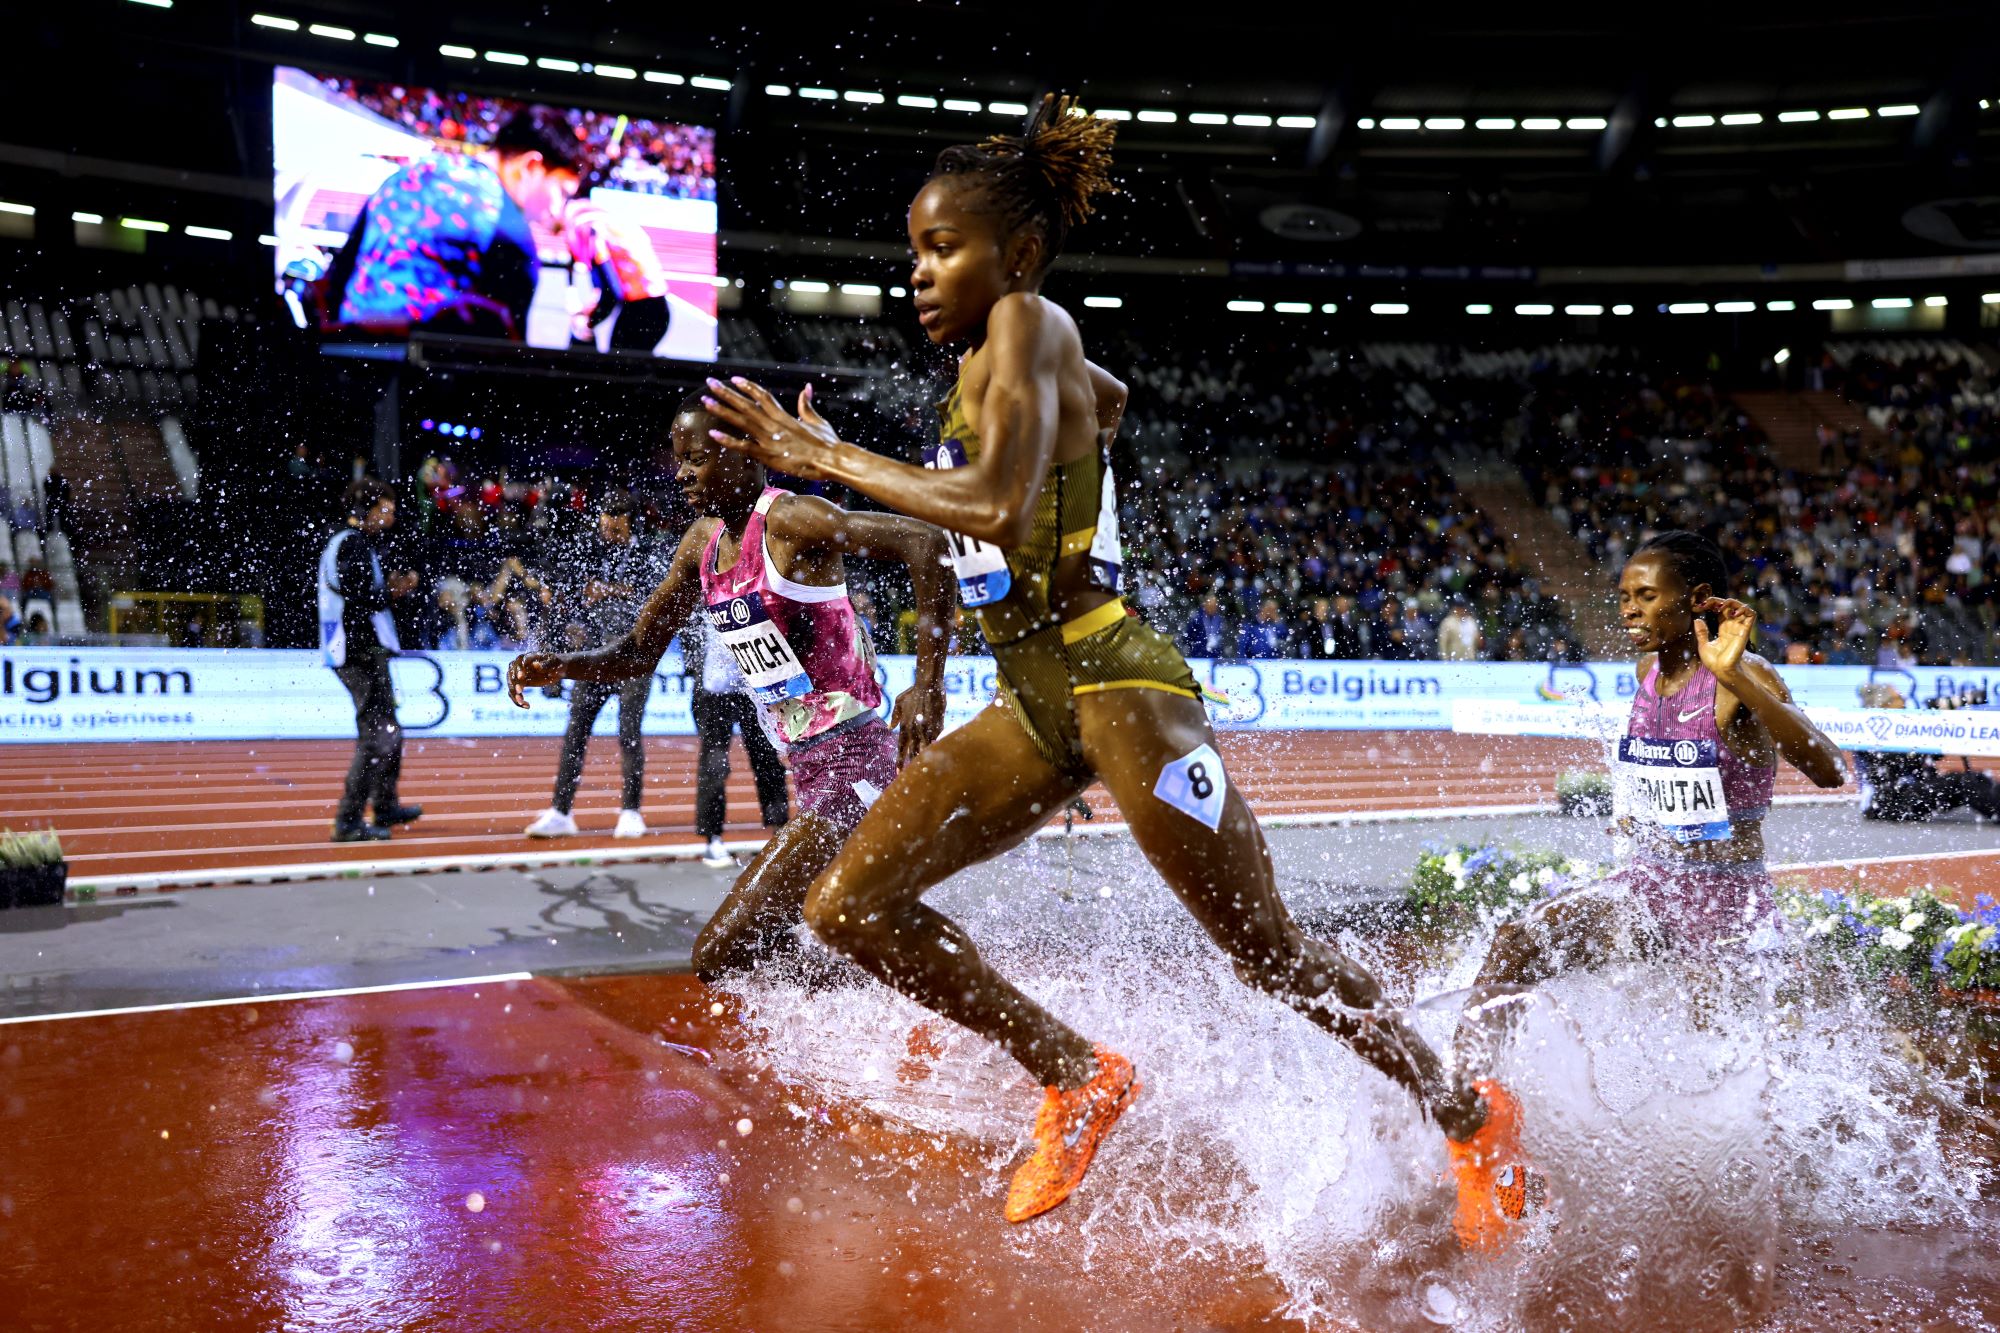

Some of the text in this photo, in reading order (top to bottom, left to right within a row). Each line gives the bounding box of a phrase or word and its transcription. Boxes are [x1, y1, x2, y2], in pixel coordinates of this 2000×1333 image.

[727, 633, 791, 675] OTICH
[1283, 668, 1441, 701] Belgium
[1894, 724, 1966, 739] DIAMOND
[1627, 739, 1672, 760] Allianz
[1187, 761, 1214, 800] 8
